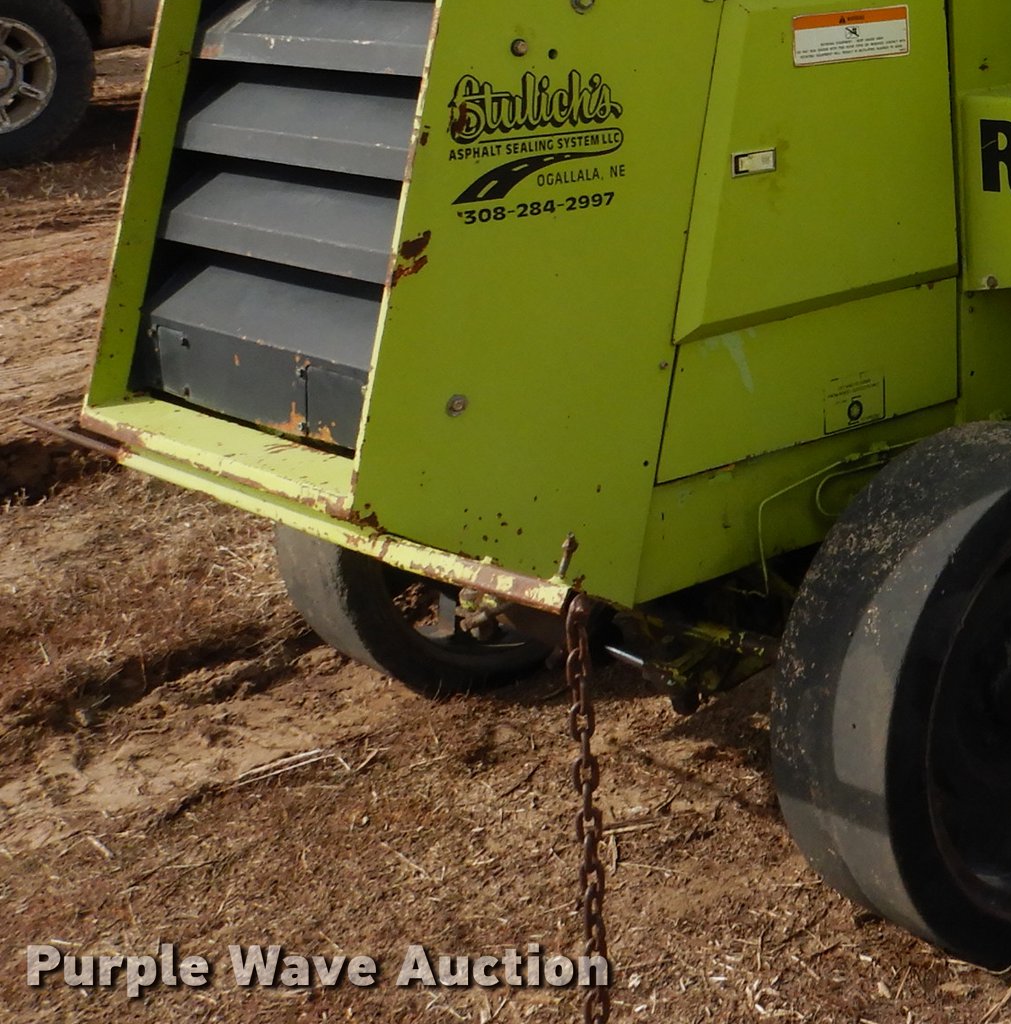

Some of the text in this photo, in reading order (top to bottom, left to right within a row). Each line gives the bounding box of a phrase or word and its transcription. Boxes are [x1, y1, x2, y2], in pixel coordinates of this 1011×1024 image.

[449, 132, 620, 161] ASPHALT SEALING SYSTEM LLC
[537, 164, 626, 187] OGALLALA, NE
[464, 191, 615, 225] 308-284-2997
